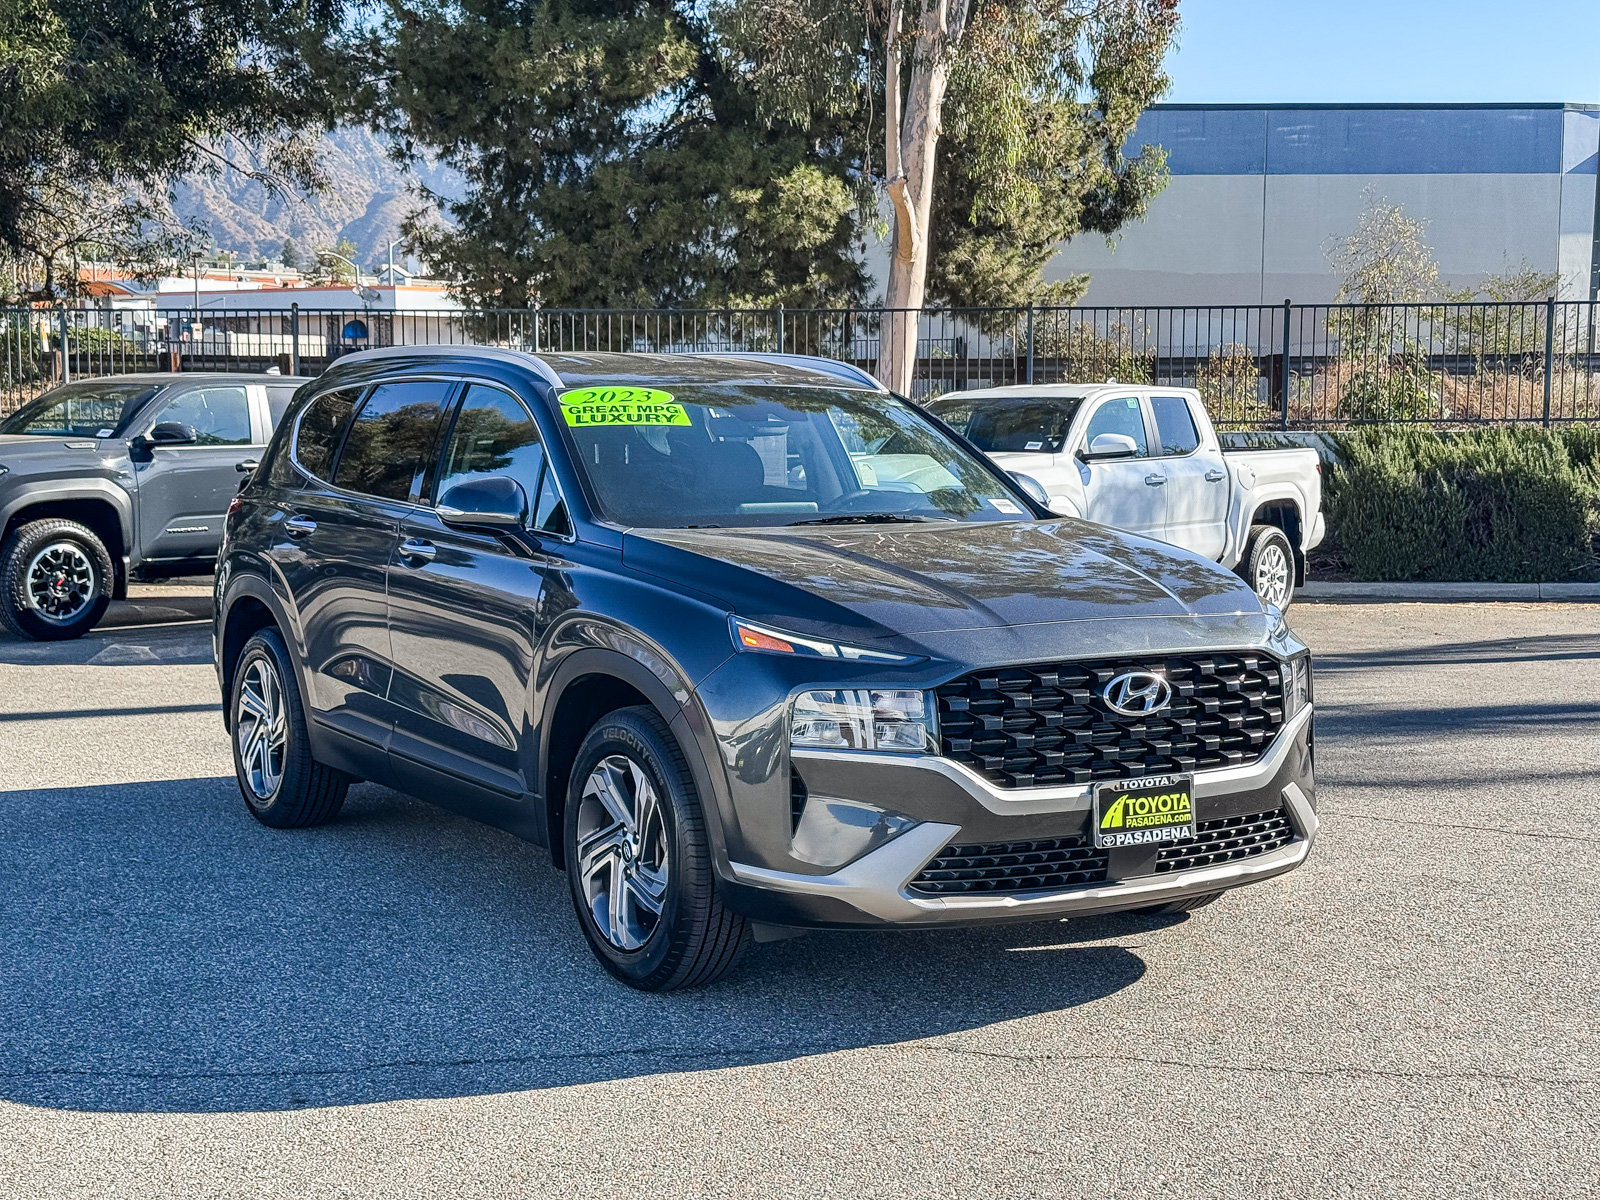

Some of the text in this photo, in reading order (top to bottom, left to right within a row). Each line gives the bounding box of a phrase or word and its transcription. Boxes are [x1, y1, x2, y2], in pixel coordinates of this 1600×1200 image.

[580, 390, 653, 404] 2023
[568, 405, 680, 414] GREAT MPG
[575, 413, 679, 424] LUXURY
[602, 727, 650, 760] VELOCITY
[1121, 777, 1169, 790] TOYOTA
[1125, 792, 1191, 816] TOYOTA
[1126, 813, 1191, 828] PASADENA.com
[1116, 826, 1191, 846] PASADENA
